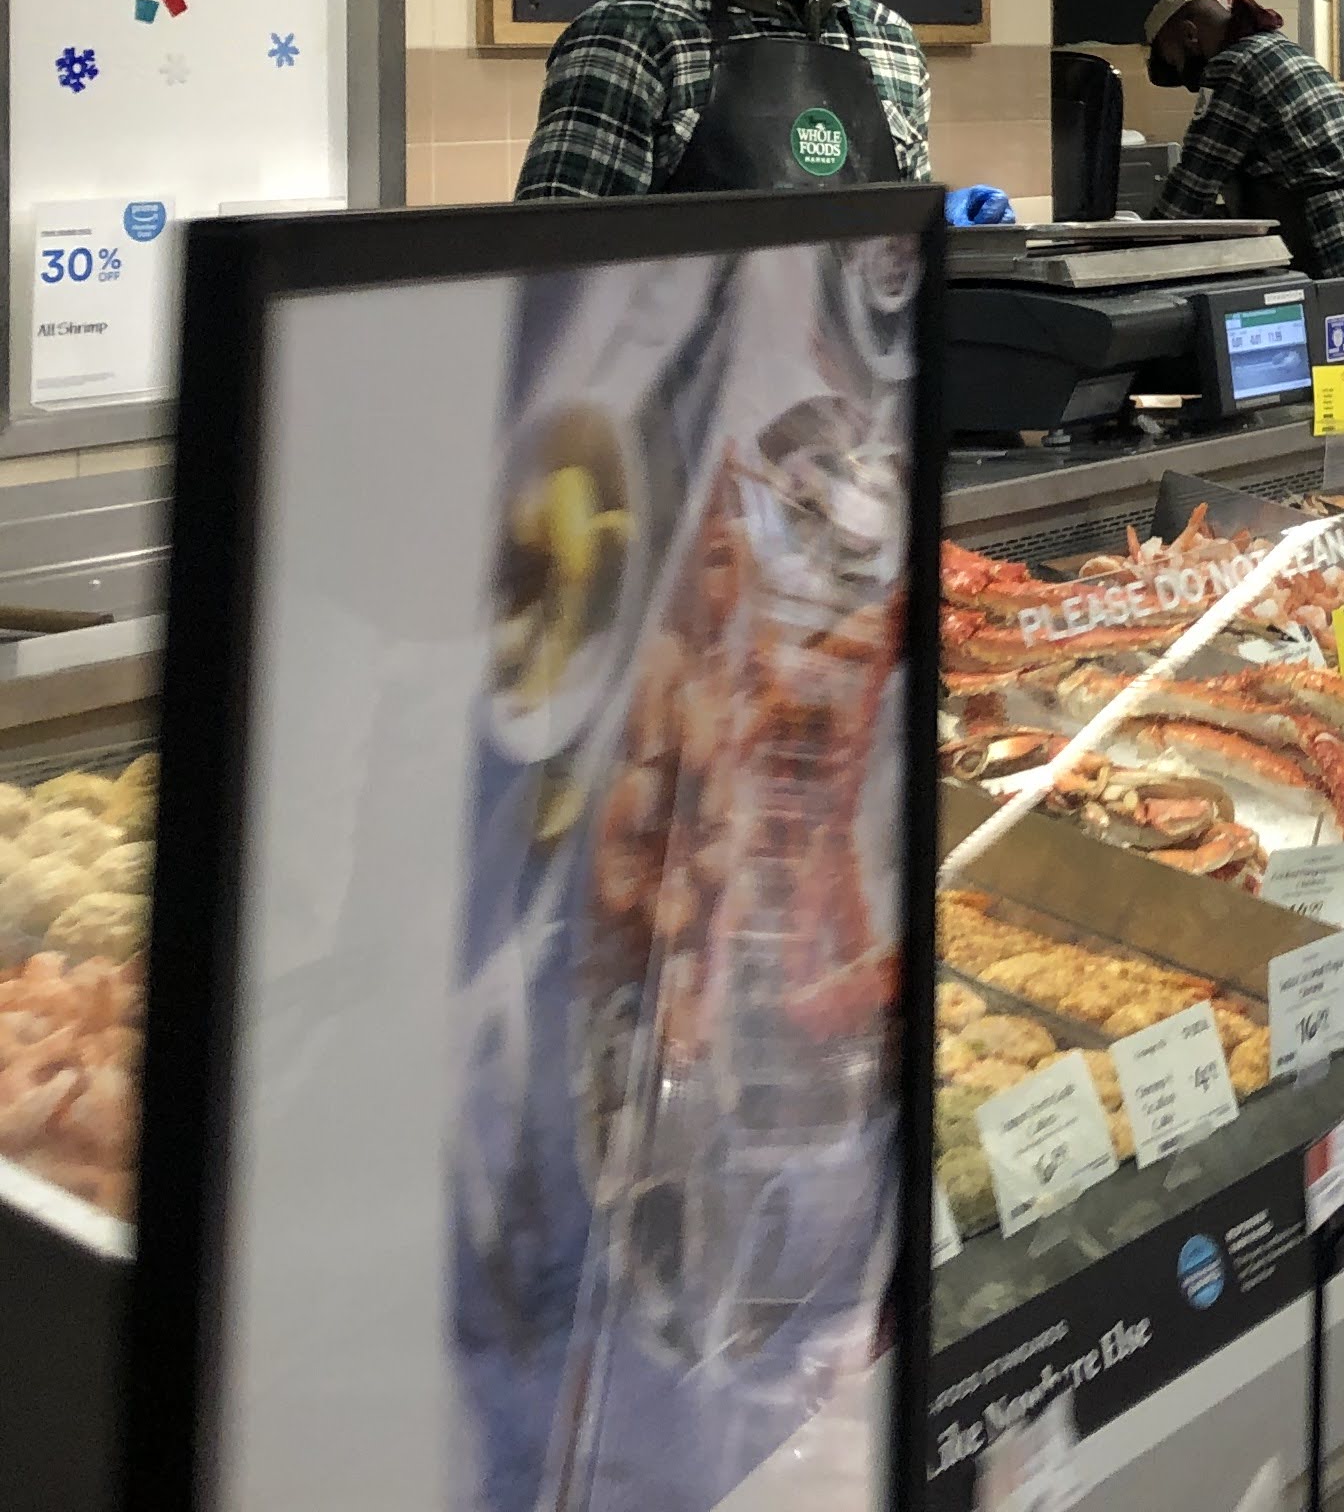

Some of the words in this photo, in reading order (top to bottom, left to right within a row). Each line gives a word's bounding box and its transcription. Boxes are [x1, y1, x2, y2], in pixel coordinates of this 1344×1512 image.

[796, 127, 842, 144] WHOLE
[799, 141, 842, 157] FOODS
[41, 247, 94, 284] 30
[98, 247, 122, 271] %
[98, 271, 121, 283] OFF
[37, 324, 55, 338] All
[57, 321, 109, 336] Shrimp
[1018, 578, 1149, 648] PLEASE
[1154, 567, 1202, 612] DO
